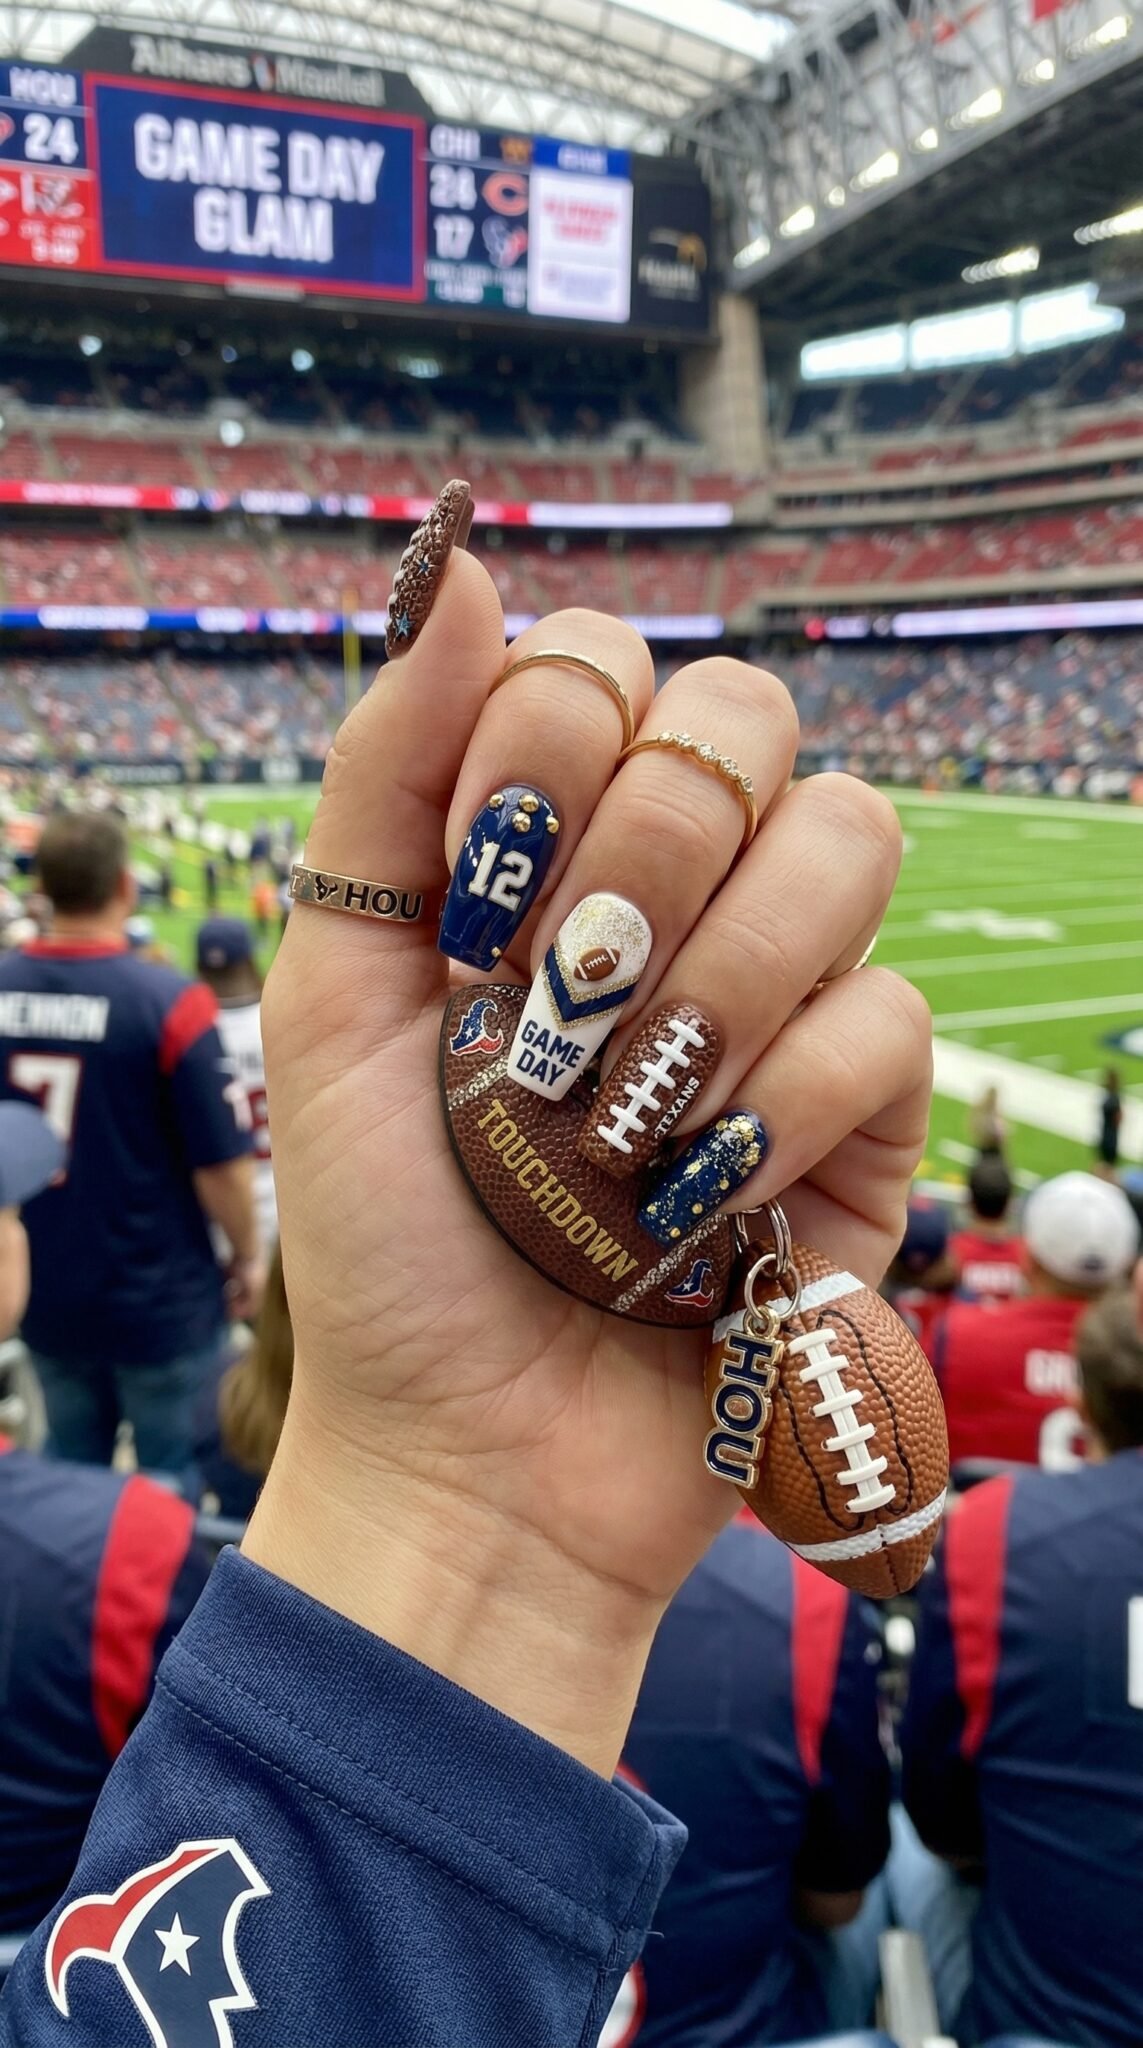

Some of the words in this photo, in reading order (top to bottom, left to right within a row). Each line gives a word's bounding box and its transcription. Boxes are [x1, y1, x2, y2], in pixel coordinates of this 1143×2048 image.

[23, 113, 79, 164] 24
[133, 113, 282, 192] GAME
[287, 131, 385, 204] DAY
[193, 187, 334, 263] GLAM
[433, 214, 475, 260] 17
[343, 882, 424, 921] HOU
[468, 840, 534, 912] 12
[516, 1049, 567, 1088] DAY
[521, 1019, 586, 1069] GAME
[654, 1076, 701, 1140] TEXANS
[477, 1098, 640, 1283] TOUCHDOWN
[703, 1328, 782, 1489] HOU
